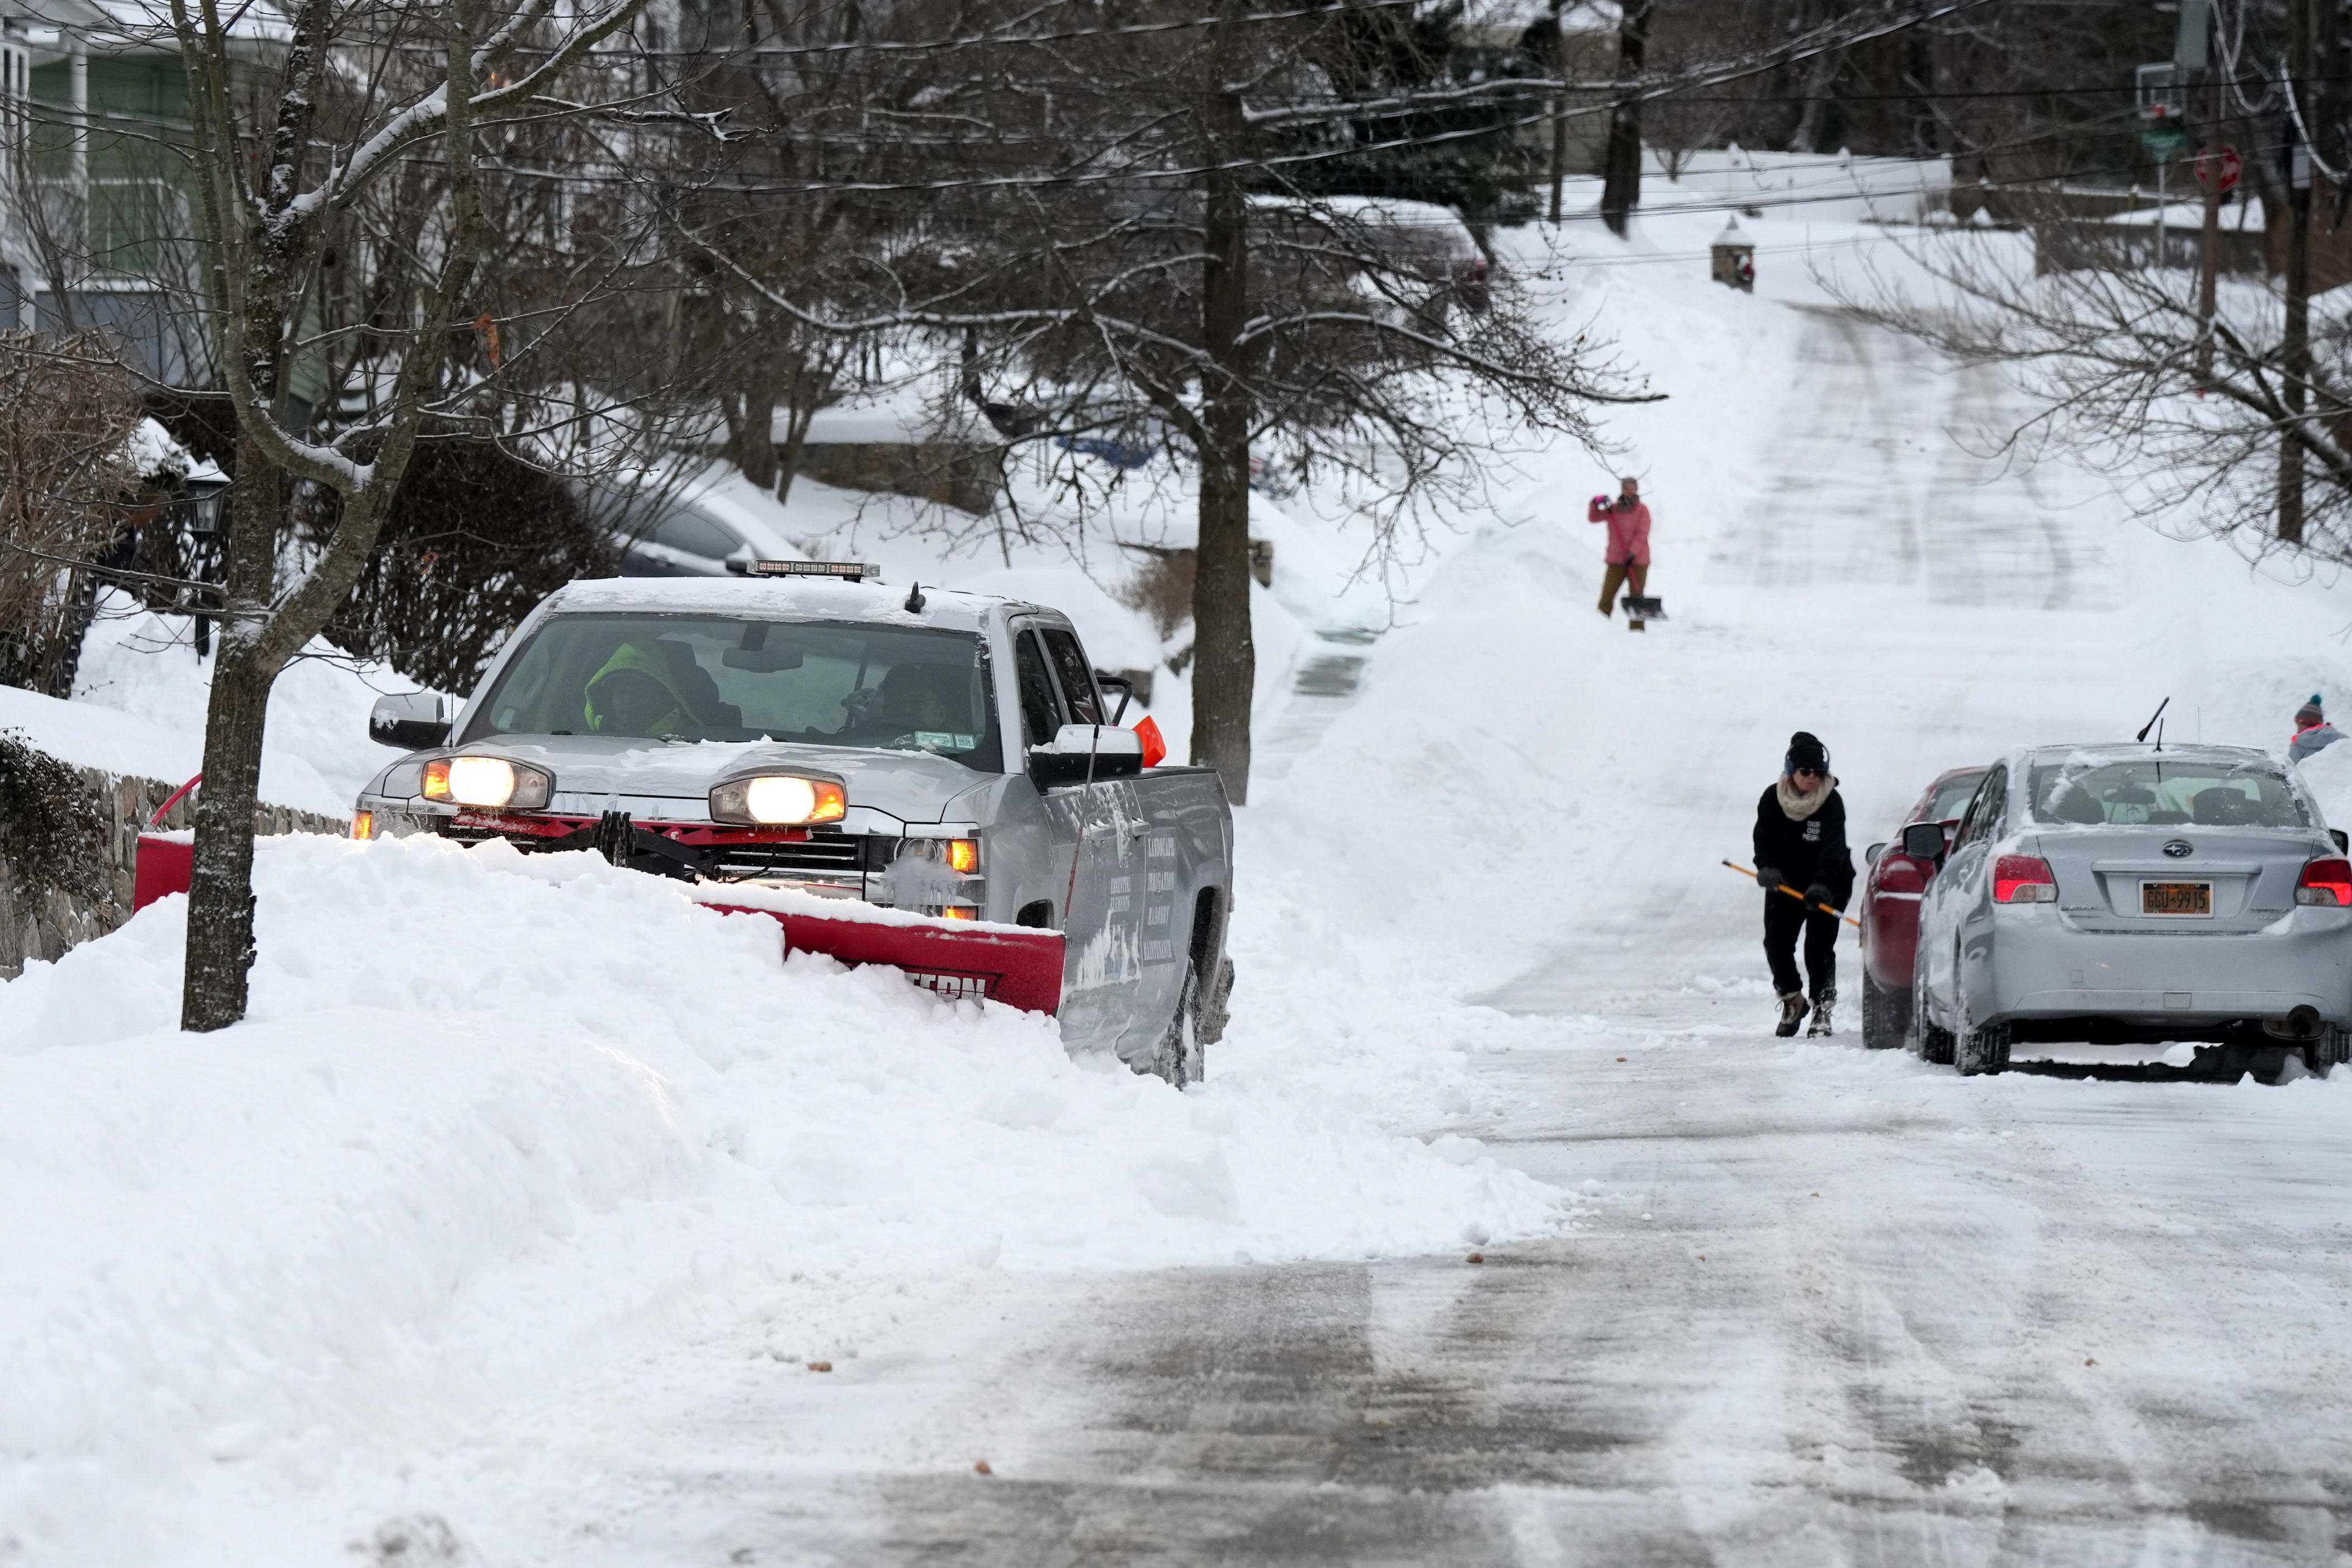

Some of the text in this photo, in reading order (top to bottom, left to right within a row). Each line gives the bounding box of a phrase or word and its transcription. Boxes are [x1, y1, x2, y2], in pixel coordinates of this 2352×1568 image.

[1148, 837, 1175, 857] LANDSCAPE
[1148, 871, 1175, 891] IRRIGATION
[1147, 906, 1170, 926] MASONRY
[1143, 939, 1172, 961] MAINTENANCE
